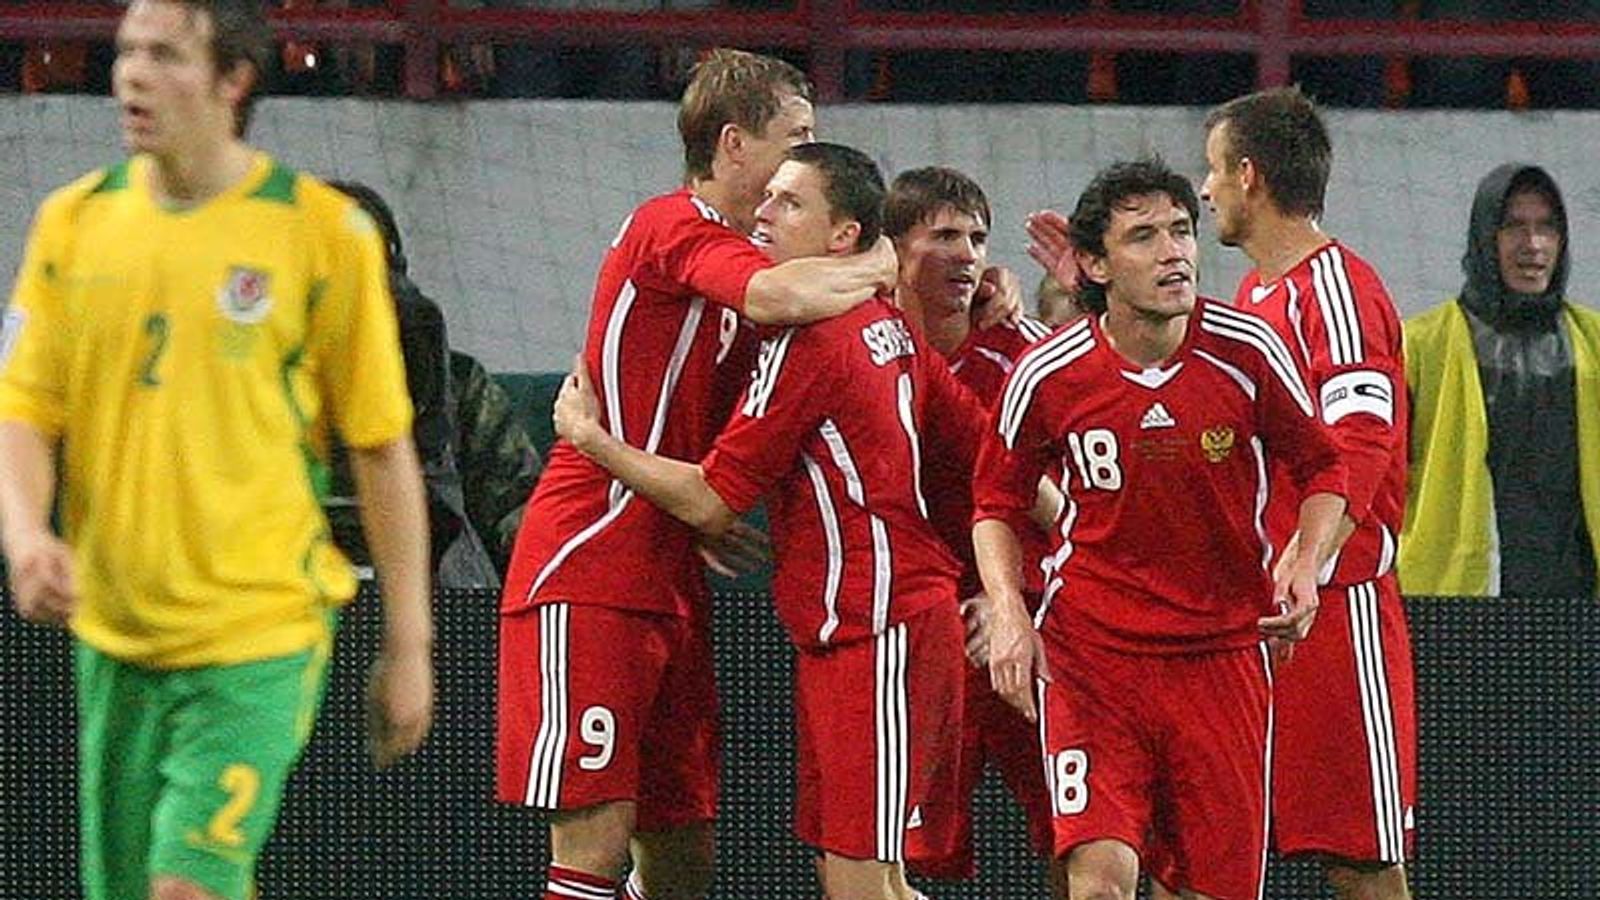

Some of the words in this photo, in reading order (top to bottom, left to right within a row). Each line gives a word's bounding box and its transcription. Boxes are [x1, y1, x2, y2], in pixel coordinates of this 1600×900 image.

[138, 314, 170, 385] 2
[1067, 428, 1123, 491] 18
[579, 705, 616, 771] 9
[207, 763, 261, 848] 2
[1047, 748, 1089, 817] 18
